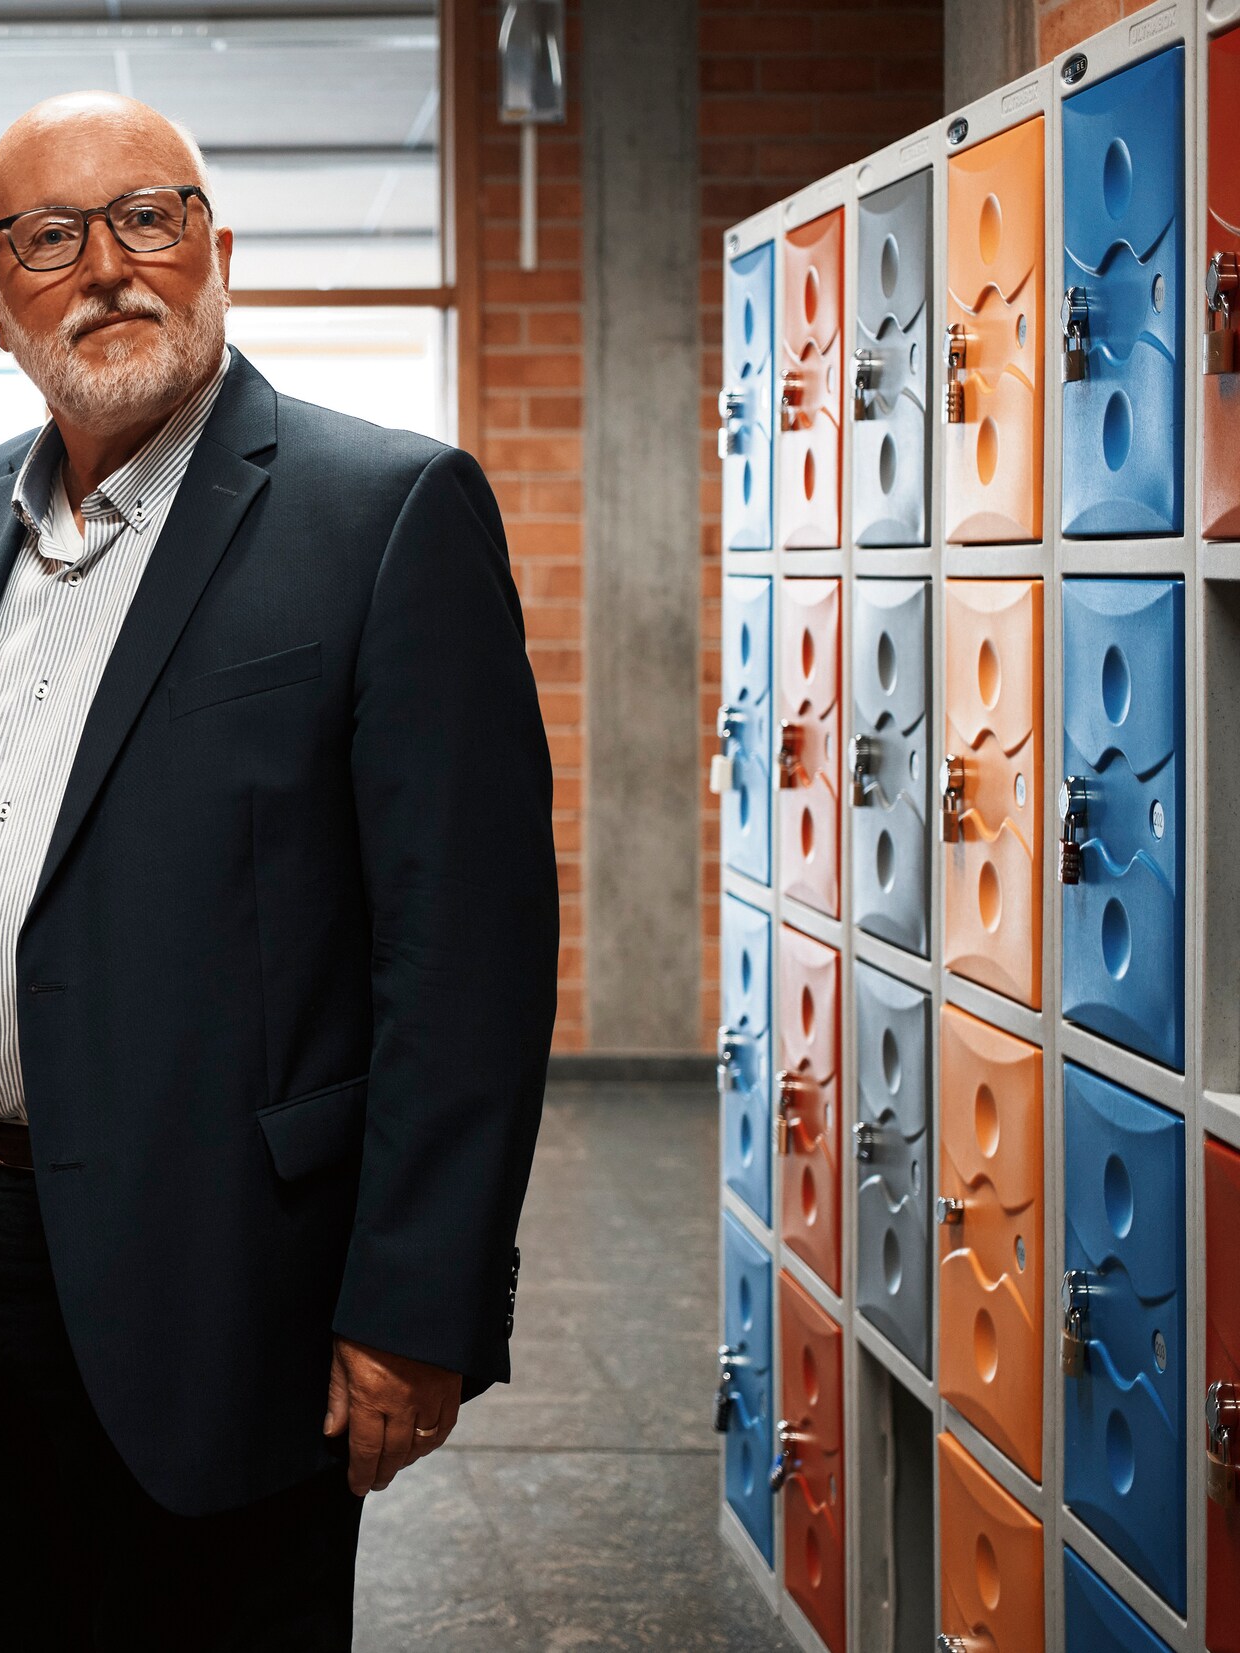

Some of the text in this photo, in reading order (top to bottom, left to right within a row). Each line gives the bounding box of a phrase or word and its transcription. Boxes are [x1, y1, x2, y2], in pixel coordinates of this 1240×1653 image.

[1154, 286, 1164, 302] 201
[1154, 811, 1163, 828] 202
[1155, 1341, 1165, 1361] 203
